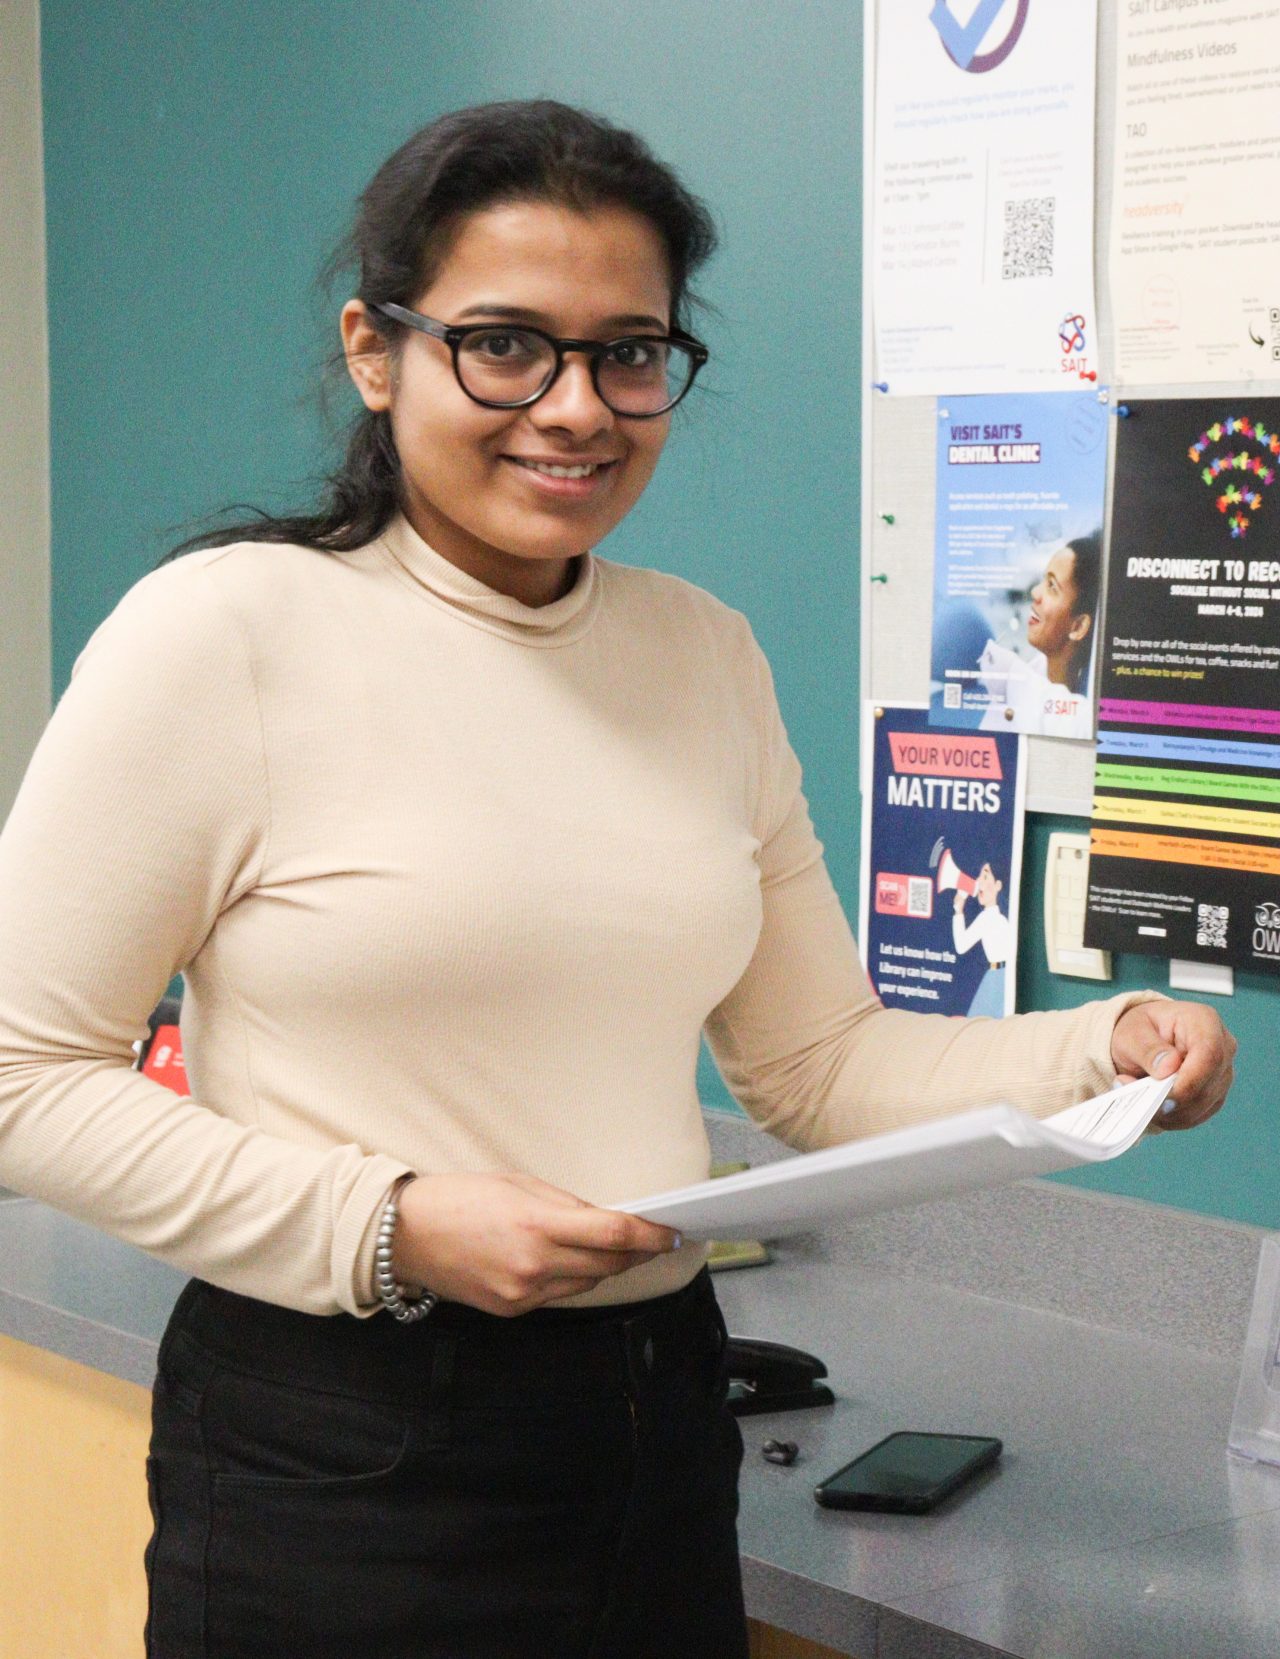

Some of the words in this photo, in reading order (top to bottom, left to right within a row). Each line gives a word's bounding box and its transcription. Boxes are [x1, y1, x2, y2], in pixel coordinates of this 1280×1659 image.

[1127, 49, 1195, 66] Mindfulness
[1197, 42, 1238, 58] Videos
[1126, 122, 1148, 137] TAO
[1061, 358, 1087, 373] SAIT
[951, 425, 980, 441] VISIT
[983, 424, 1022, 440] SAIT'S
[949, 446, 997, 463] DENTAL
[998, 444, 1039, 462] CLINIC
[1128, 558, 1220, 579] DISCONNECT
[1224, 560, 1245, 581] TO
[1054, 701, 1078, 715] SAIT
[899, 746, 939, 765] YOUR
[942, 749, 991, 769] VOICE
[887, 775, 1001, 814] MATTERS
[879, 942, 892, 955] Let
[893, 947, 903, 956] us
[903, 946, 924, 959] know
[925, 948, 942, 961] how
[942, 950, 957, 964] the
[879, 961, 906, 978] Library
[907, 968, 920, 977] can
[921, 967, 953, 983] improve
